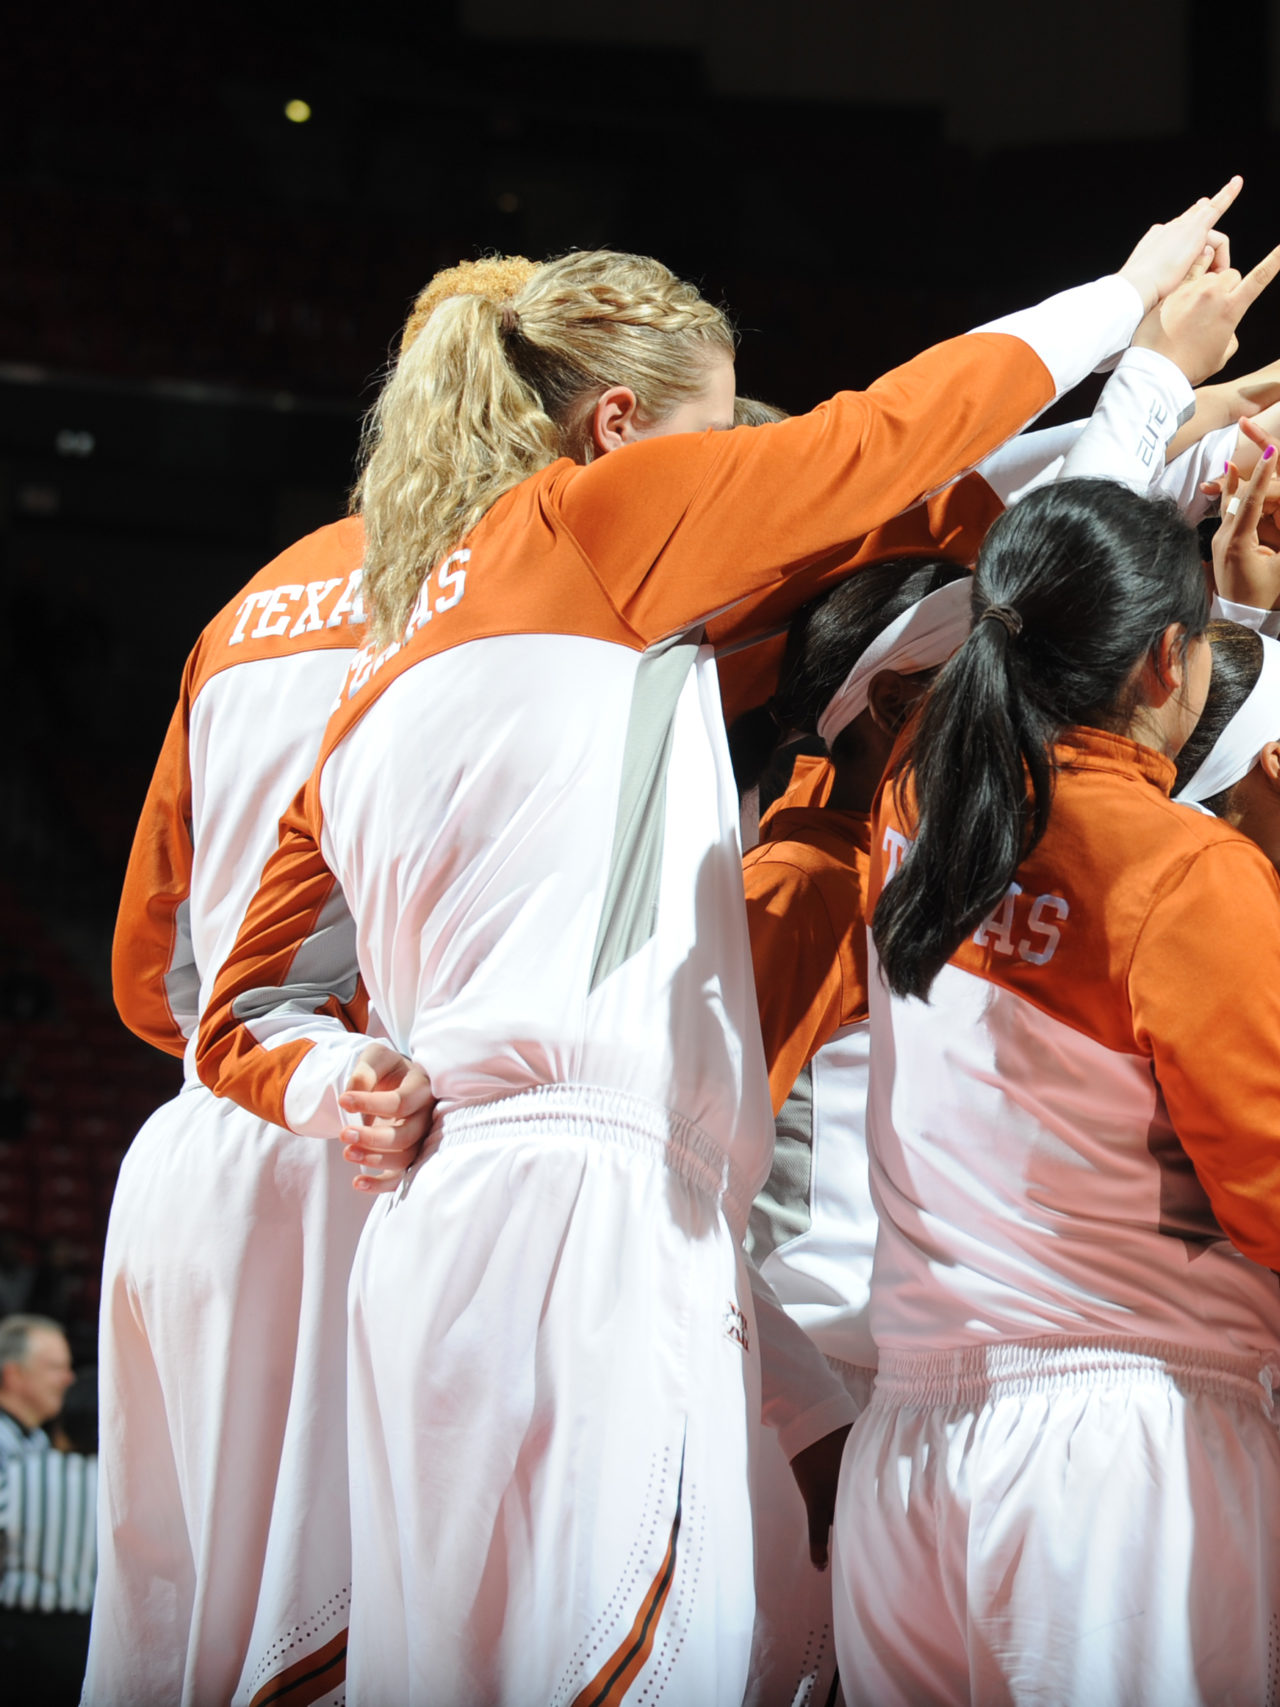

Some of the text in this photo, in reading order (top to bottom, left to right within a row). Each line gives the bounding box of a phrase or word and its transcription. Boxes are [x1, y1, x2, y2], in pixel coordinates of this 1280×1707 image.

[1136, 398, 1168, 468] ELITE
[228, 568, 368, 646] TEXA
[882, 826, 1069, 966] TAS
